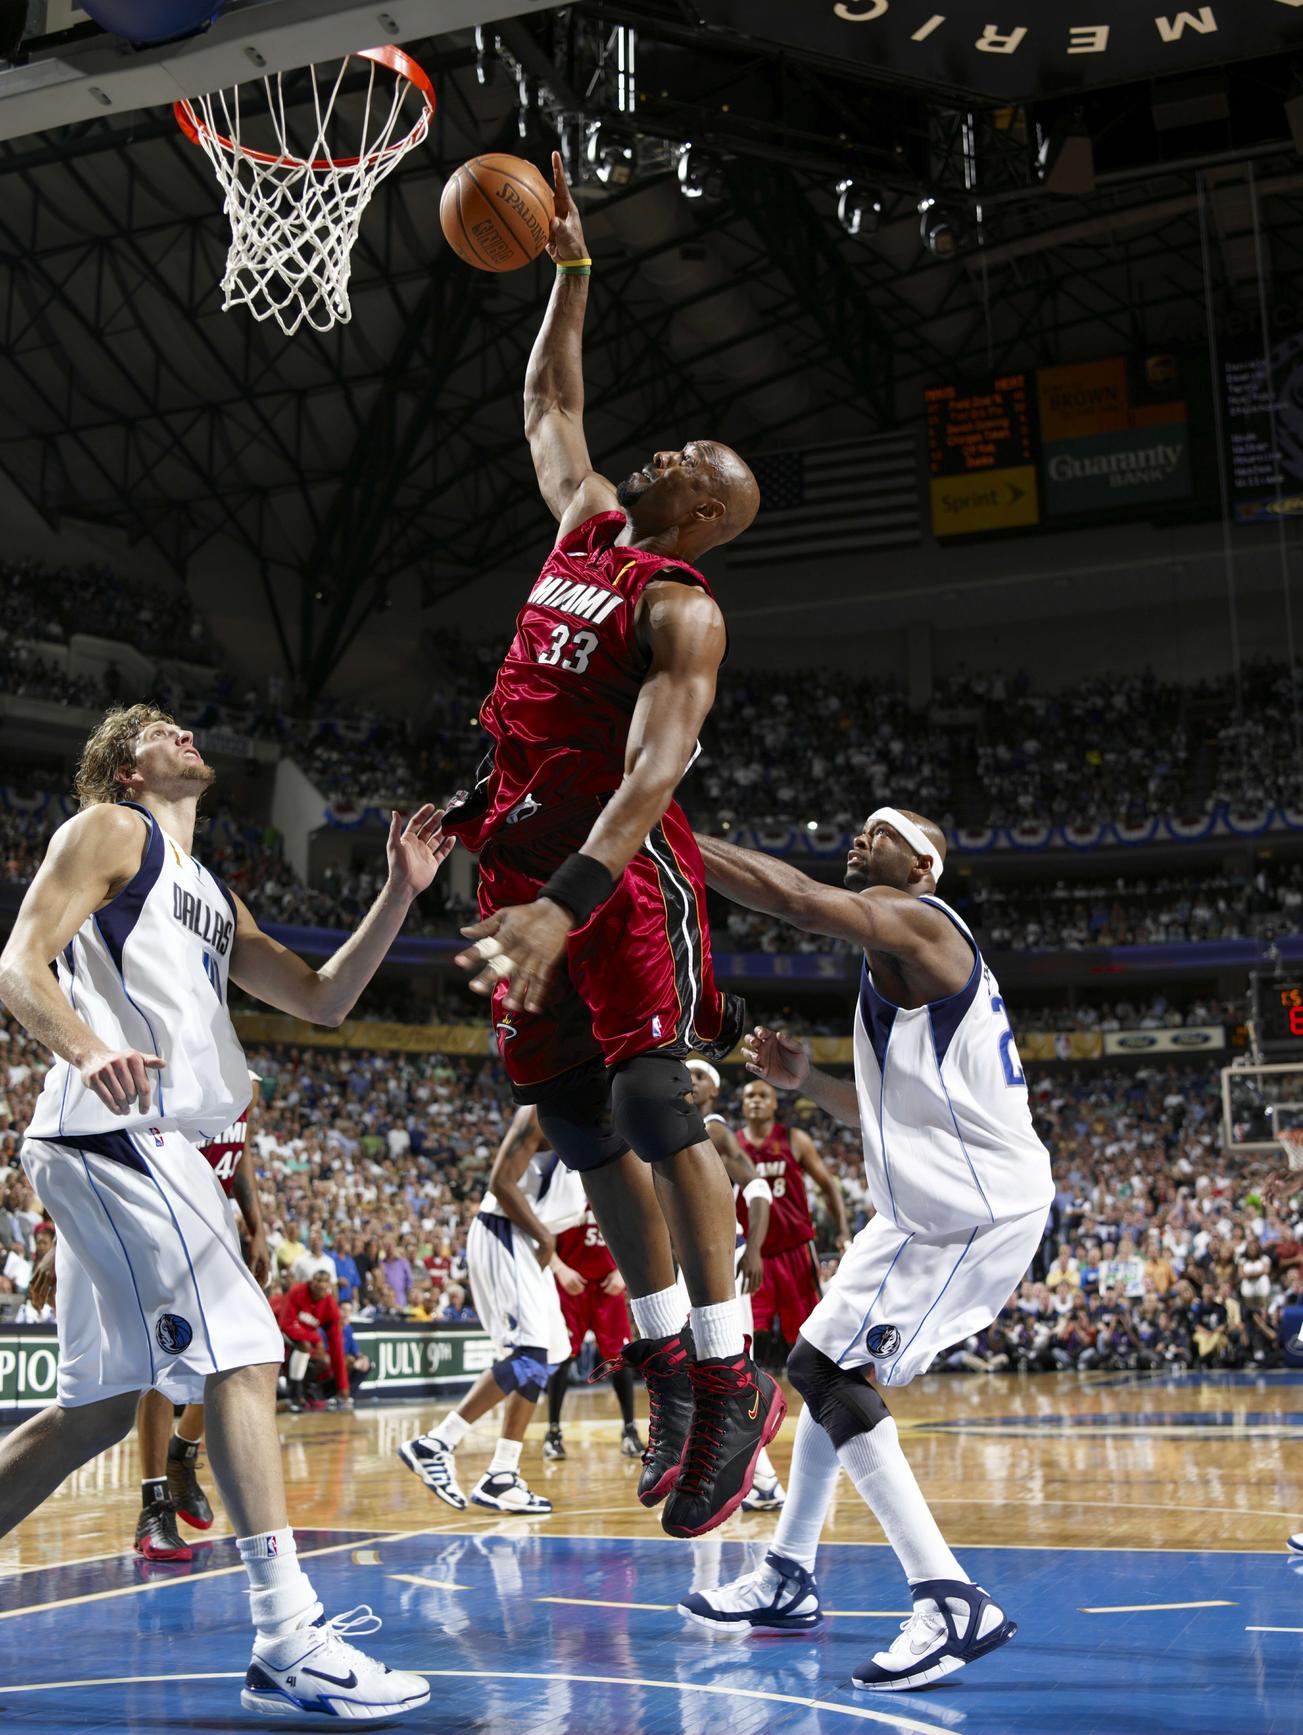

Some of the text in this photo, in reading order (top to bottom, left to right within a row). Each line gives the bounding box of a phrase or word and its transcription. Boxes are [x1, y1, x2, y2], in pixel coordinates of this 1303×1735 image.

[833, 0, 1303, 54] MERIC
[496, 182, 547, 248] SPALDING
[1048, 443, 1184, 482] Guaranty
[1107, 466, 1167, 488] BANK
[942, 488, 998, 515] Sprint
[527, 575, 625, 626] MIAMI
[537, 623, 599, 676] 33
[173, 881, 233, 956] DALLAS
[374, 1341, 424, 1379] JULY
[427, 1343, 452, 1374] 9TH
[286, 1675, 297, 1688] 41
